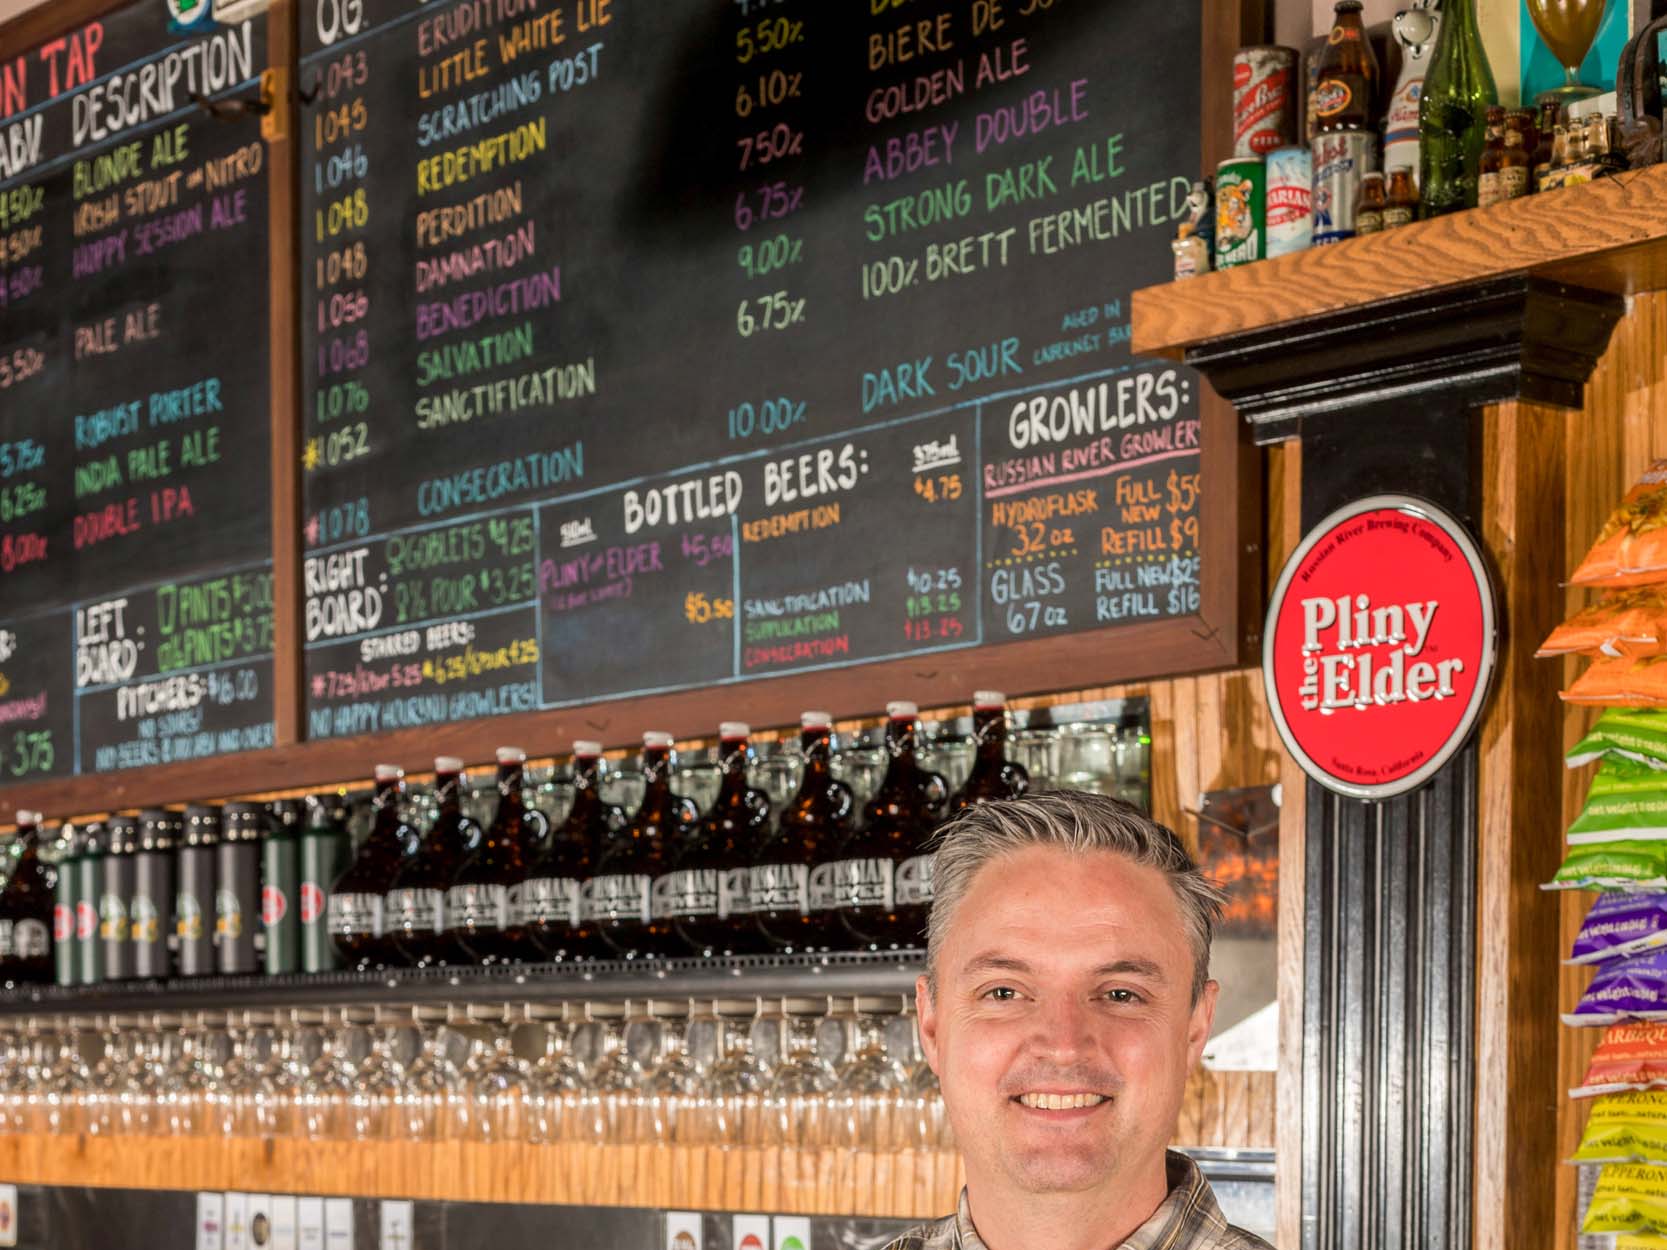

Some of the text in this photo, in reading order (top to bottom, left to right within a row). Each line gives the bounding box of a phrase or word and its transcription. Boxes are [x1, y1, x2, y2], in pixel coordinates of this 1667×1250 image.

[0, 22, 104, 118] N TAP
[72, 20, 251, 147] DESCRIPTION
[419, 38, 490, 99] LITTLE
[500, 8, 566, 64] WHITE
[417, 70, 542, 147] SCRATCHING
[549, 42, 604, 95] POST
[417, 116, 547, 197] REDEMPTION
[869, 13, 953, 71] BIERE
[972, 0, 1004, 36] DE
[73, 123, 190, 200] BLONDE ALE
[416, 179, 522, 249] PERDITION
[866, 60, 964, 124] GOLDEN
[976, 38, 1031, 89] ALE
[125, 170, 183, 216] STOUT
[206, 142, 262, 192] NITRO
[416, 220, 535, 294] DAMNATION
[863, 121, 959, 185] ABBEY
[976, 78, 1088, 153] DOUBLE
[134, 202, 202, 256] SESSION
[210, 188, 247, 229] ALE
[415, 266, 561, 341] BENEDICTION
[863, 179, 971, 242] STRONG
[986, 155, 1058, 213] DARK
[1071, 133, 1126, 188] ALE
[416, 321, 534, 387] SALVATION
[736, 291, 806, 337] 6.75%
[862, 255, 919, 300] 100%
[926, 226, 1016, 281] BRETT
[1029, 175, 1191, 255] FERMENTED
[75, 318, 118, 359] PALE
[123, 304, 160, 343] ALE
[75, 401, 142, 449] ROBUST
[149, 378, 223, 425] PORTER
[415, 358, 596, 429] SANCTIFICATION
[417, 440, 584, 516] CONSECRATION
[862, 356, 935, 413] DARK
[947, 337, 1024, 390] SOUR
[1009, 370, 1190, 449] GROWLERS:
[75, 456, 122, 497] INDIA
[128, 440, 171, 482] PALE
[181, 427, 220, 466] ALE
[984, 420, 1200, 488] RUSSIAN RIVER GROWLER
[74, 499, 140, 550] DOUBLE
[151, 486, 195, 524] IPA
[624, 443, 869, 535] BOTTLED BEERS:
[742, 502, 840, 542] REDEMPTION
[1116, 475, 1162, 506] FULL
[1012, 522, 1046, 556] 32
[1122, 505, 1161, 525] NEW
[1102, 526, 1166, 555] REFILL
[1335, 524, 1364, 545] River
[1367, 519, 1410, 534] Brewing
[1411, 522, 1453, 562] Company
[304, 548, 369, 597] RIGHT
[431, 574, 479, 614] POUR
[539, 553, 591, 594] PLINY
[606, 541, 663, 579] ELDER
[991, 562, 1066, 605] GLASS
[1095, 568, 1135, 594] FULL
[1137, 565, 1170, 587] NEW
[77, 598, 127, 646] LEFT
[1007, 601, 1041, 634] 67
[1096, 592, 1159, 621] REFILL
[1301, 593, 1439, 657] Pliny
[1299, 648, 1464, 714] the Elder
[309, 706, 333, 738] NO
